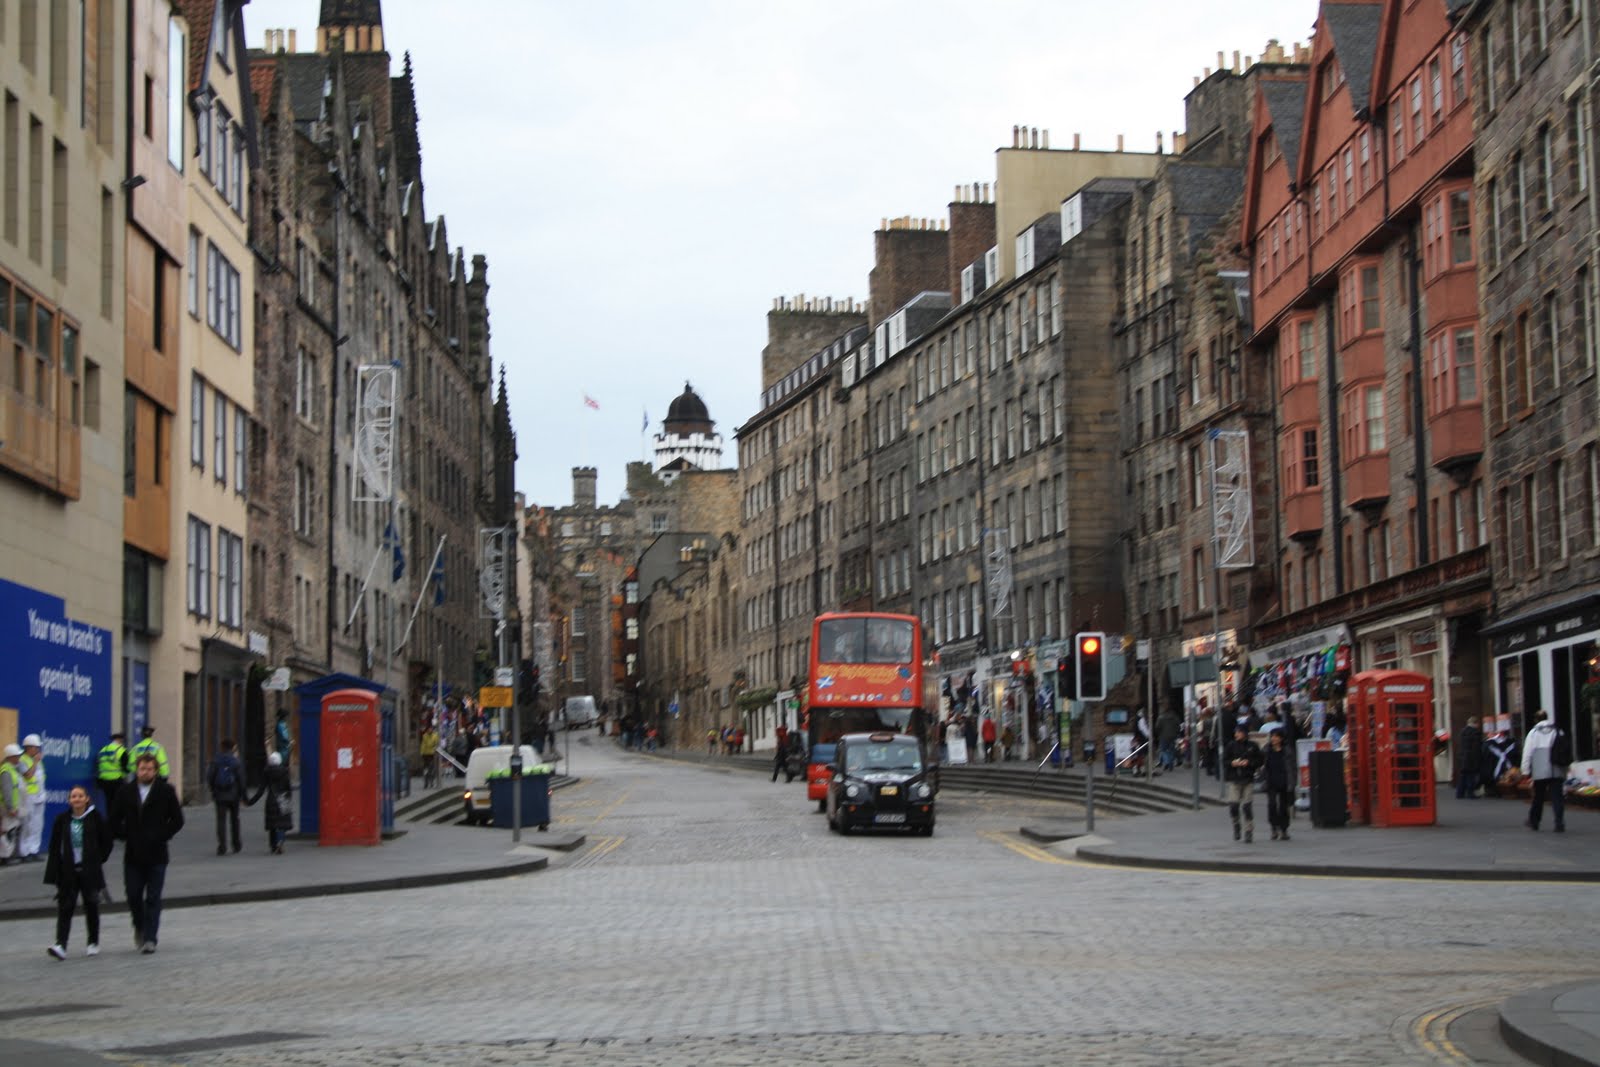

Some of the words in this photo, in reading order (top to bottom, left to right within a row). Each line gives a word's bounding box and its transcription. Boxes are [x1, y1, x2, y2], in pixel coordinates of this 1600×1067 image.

[28, 608, 49, 640] Your
[49, 622, 67, 645] new
[67, 618, 94, 652] branch
[94, 628, 102, 655] is
[39, 662, 74, 700] opening
[73, 664, 92, 696] here
